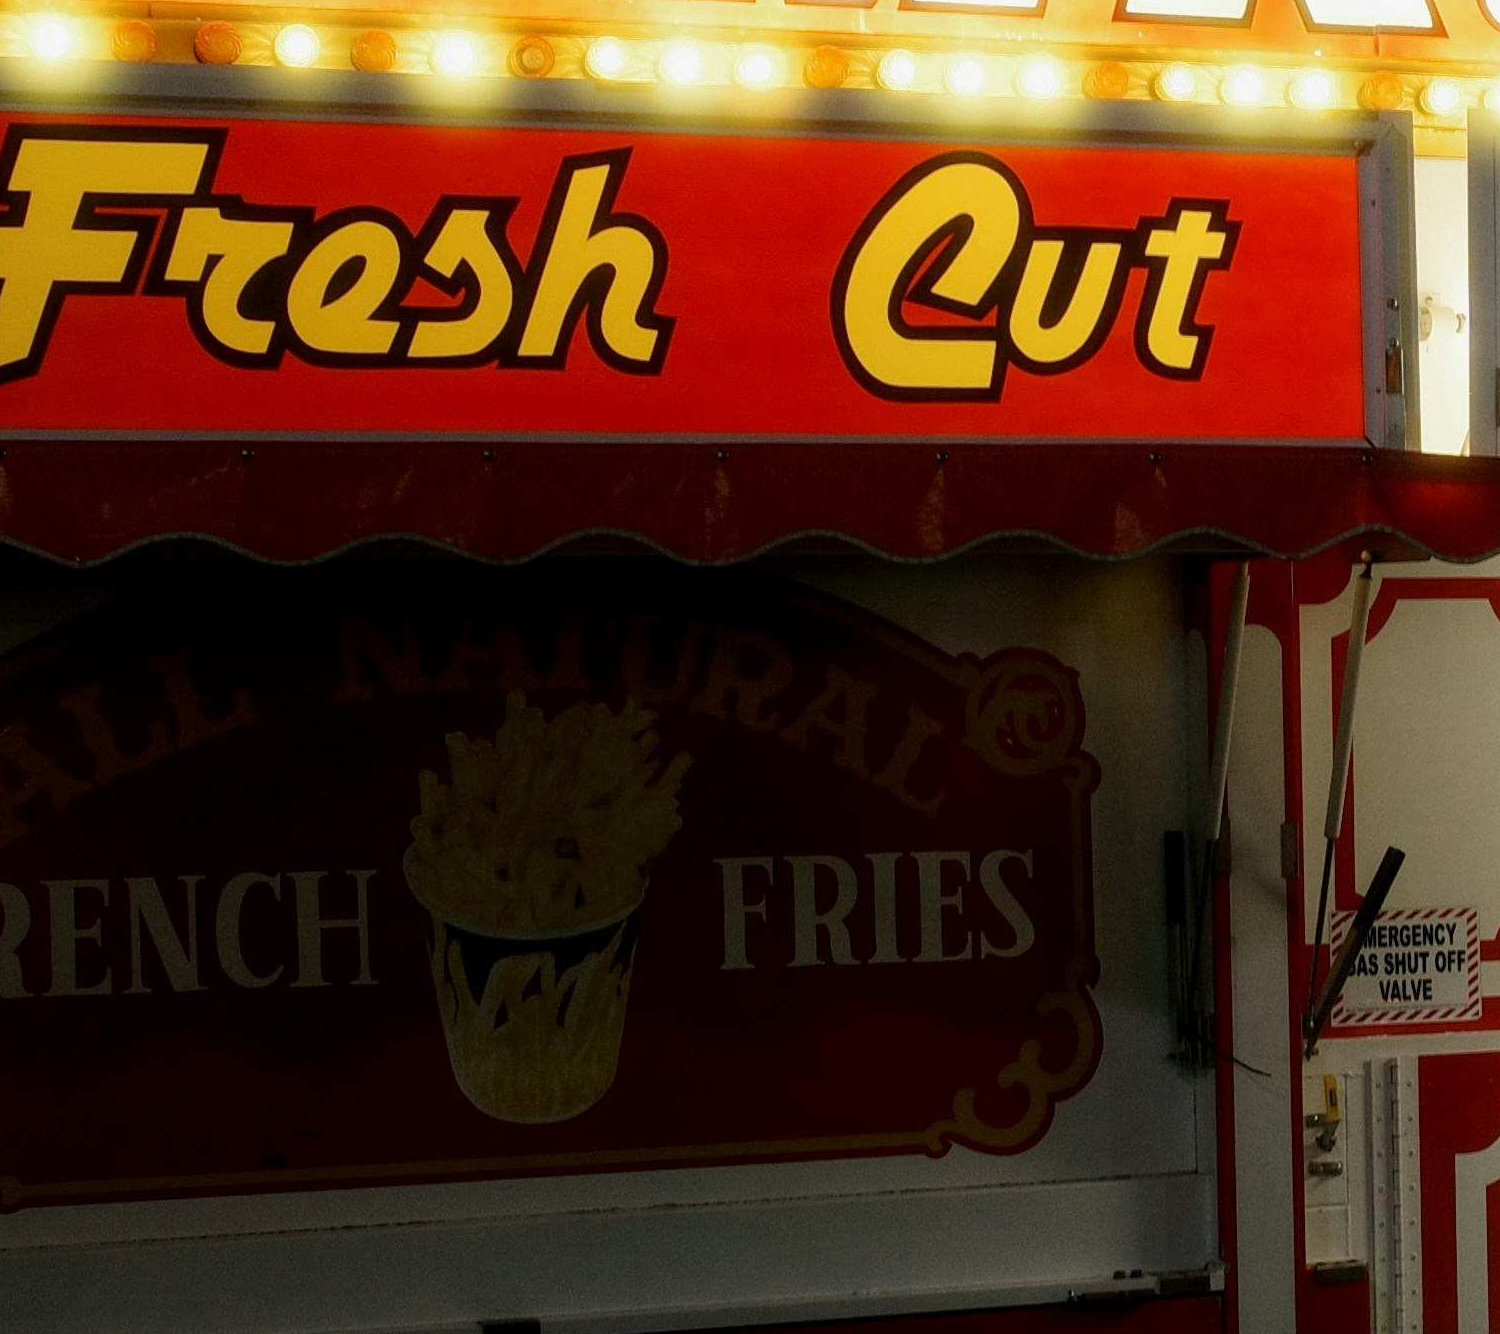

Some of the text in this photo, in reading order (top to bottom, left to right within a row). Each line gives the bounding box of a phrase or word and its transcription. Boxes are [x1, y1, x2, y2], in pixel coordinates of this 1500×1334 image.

[829, 149, 1240, 404] Cut
[334, 595, 949, 820] NATURAL
[711, 846, 1039, 972] FRIES
[1364, 923, 1457, 948] MERGENCY
[1379, 979, 1433, 1002] VALVE
[1384, 951, 1430, 976] SHUT
[1435, 950, 1466, 973] OFF
